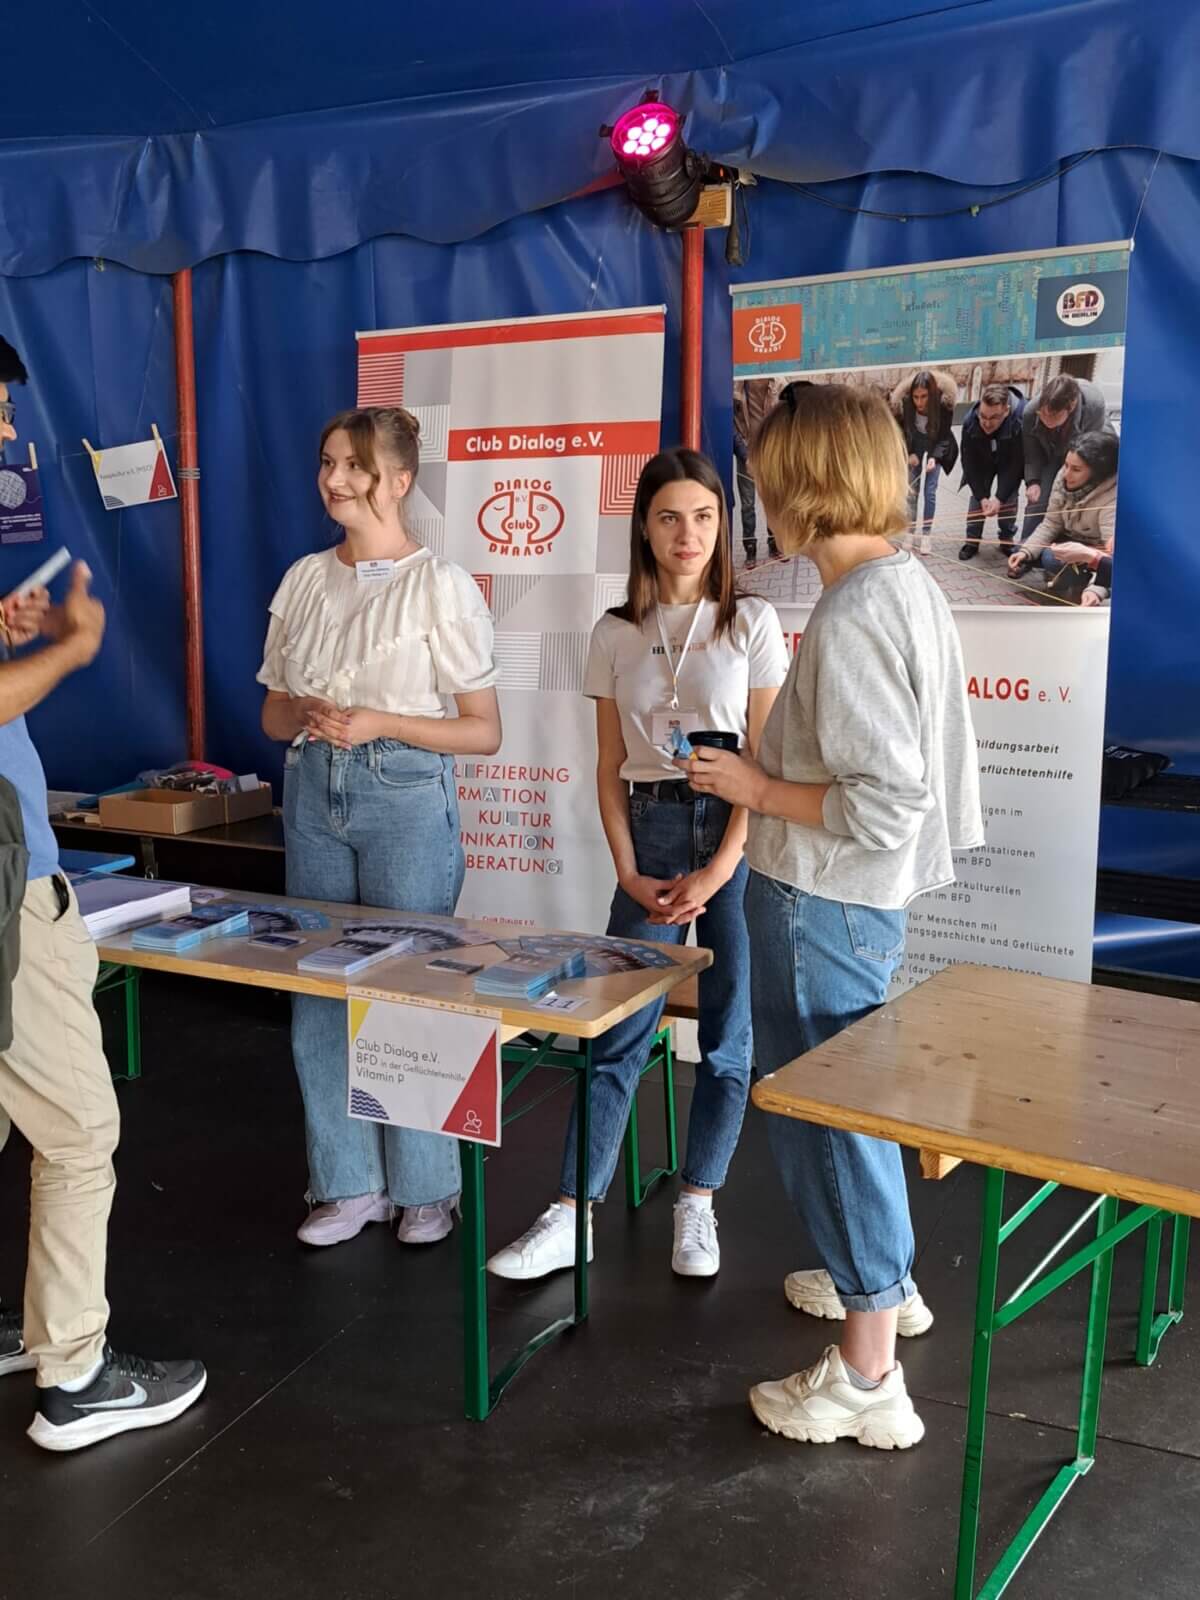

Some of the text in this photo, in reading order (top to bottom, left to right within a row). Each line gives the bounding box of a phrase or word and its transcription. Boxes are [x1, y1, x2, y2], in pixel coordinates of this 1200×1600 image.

[1063, 290, 1099, 309] BFD
[1071, 311, 1098, 319] BERLIN
[466, 431, 604, 453] Club Dialog e.V.
[494, 478, 552, 492] DIALOG
[507, 519, 533, 530] club
[458, 786, 546, 804] RMATION
[479, 810, 552, 828] KULTUR
[1010, 807, 1023, 817] im
[466, 854, 561, 874] BERATUNG
[971, 856, 991, 867] BFD
[951, 892, 971, 903] BFD
[908, 912, 997, 932] für Menschen mit
[990, 936, 1009, 948] und
[1012, 938, 1075, 957] Geflüchtete
[908, 952, 926, 961] und
[356, 1038, 440, 1064] Club Dialog e.V.
[356, 1051, 378, 1066] BFD
[356, 1066, 404, 1084] Vitamin P
